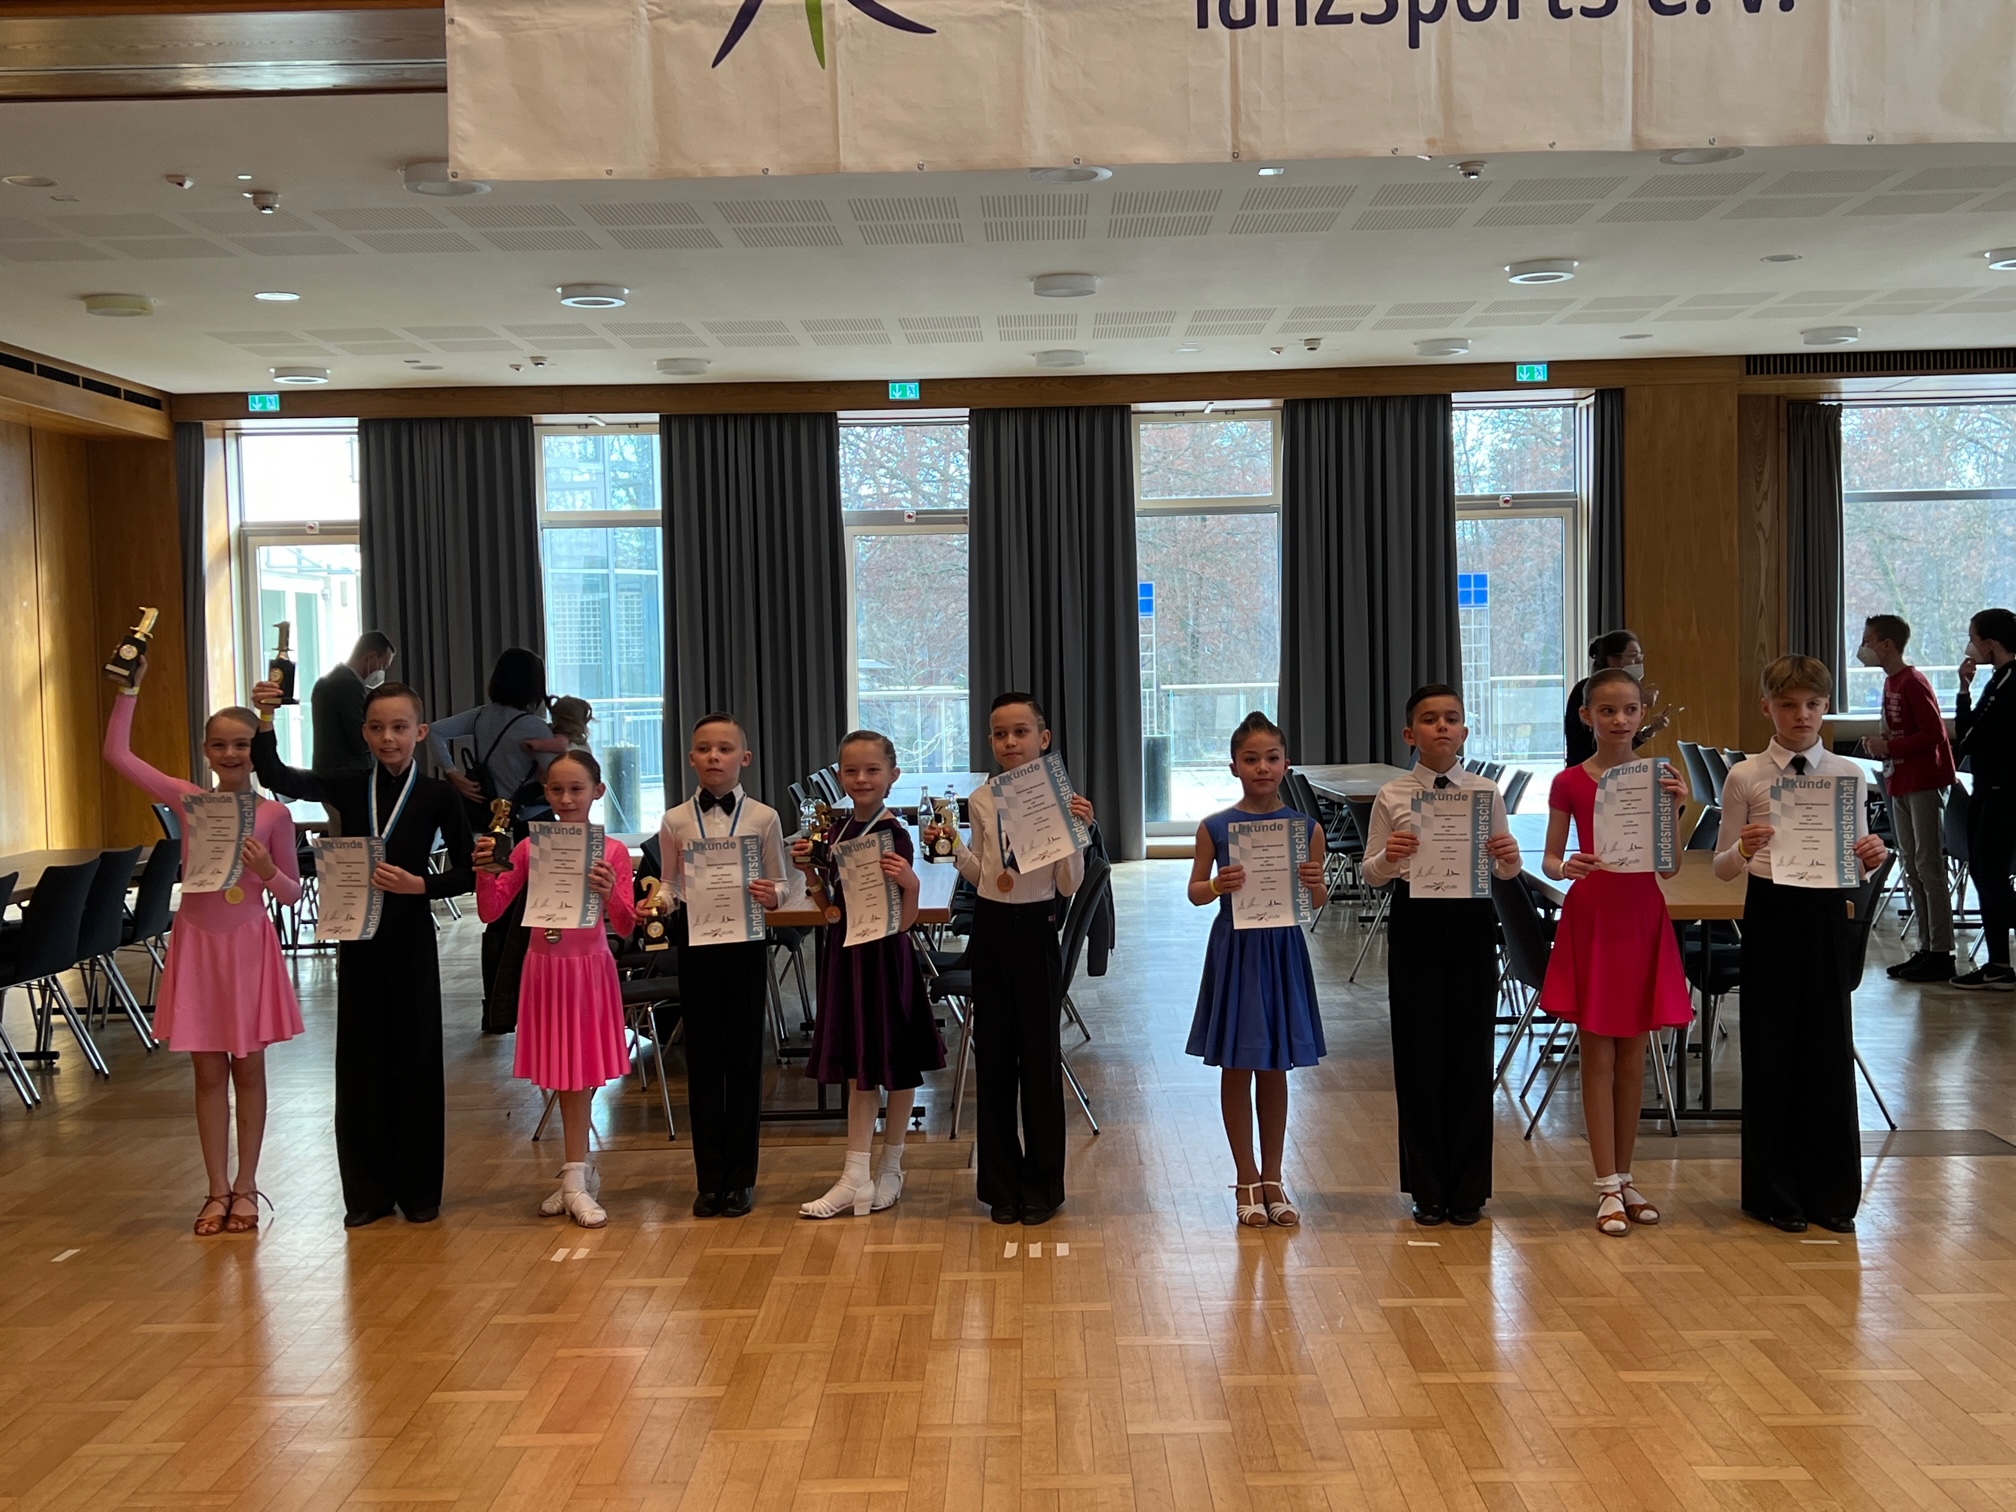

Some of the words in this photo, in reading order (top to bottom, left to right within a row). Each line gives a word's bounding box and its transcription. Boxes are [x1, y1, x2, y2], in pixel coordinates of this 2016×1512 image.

[993, 763, 1041, 786] Urkunde
[1416, 791, 1469, 802] Urkunde
[1776, 777, 1831, 789] Urkunde
[222, 794, 254, 889] Landeterschaft
[533, 824, 583, 836] Urkunde
[687, 840, 737, 851] Urkunde
[835, 838, 876, 855] Urkunde
[1233, 822, 1284, 833] Urkunde
[1292, 820, 1312, 923] Landesmterschaft
[1475, 792, 1492, 896] Landesmeisterschaft
[1839, 779, 1857, 886] Landesmeisterschaft
[362, 839, 384, 938] Landesmechaft
[581, 825, 603, 927] Landeserschaft
[744, 838, 763, 938] Landesmterschaft
[881, 832, 901, 934] Landesmeishaft
